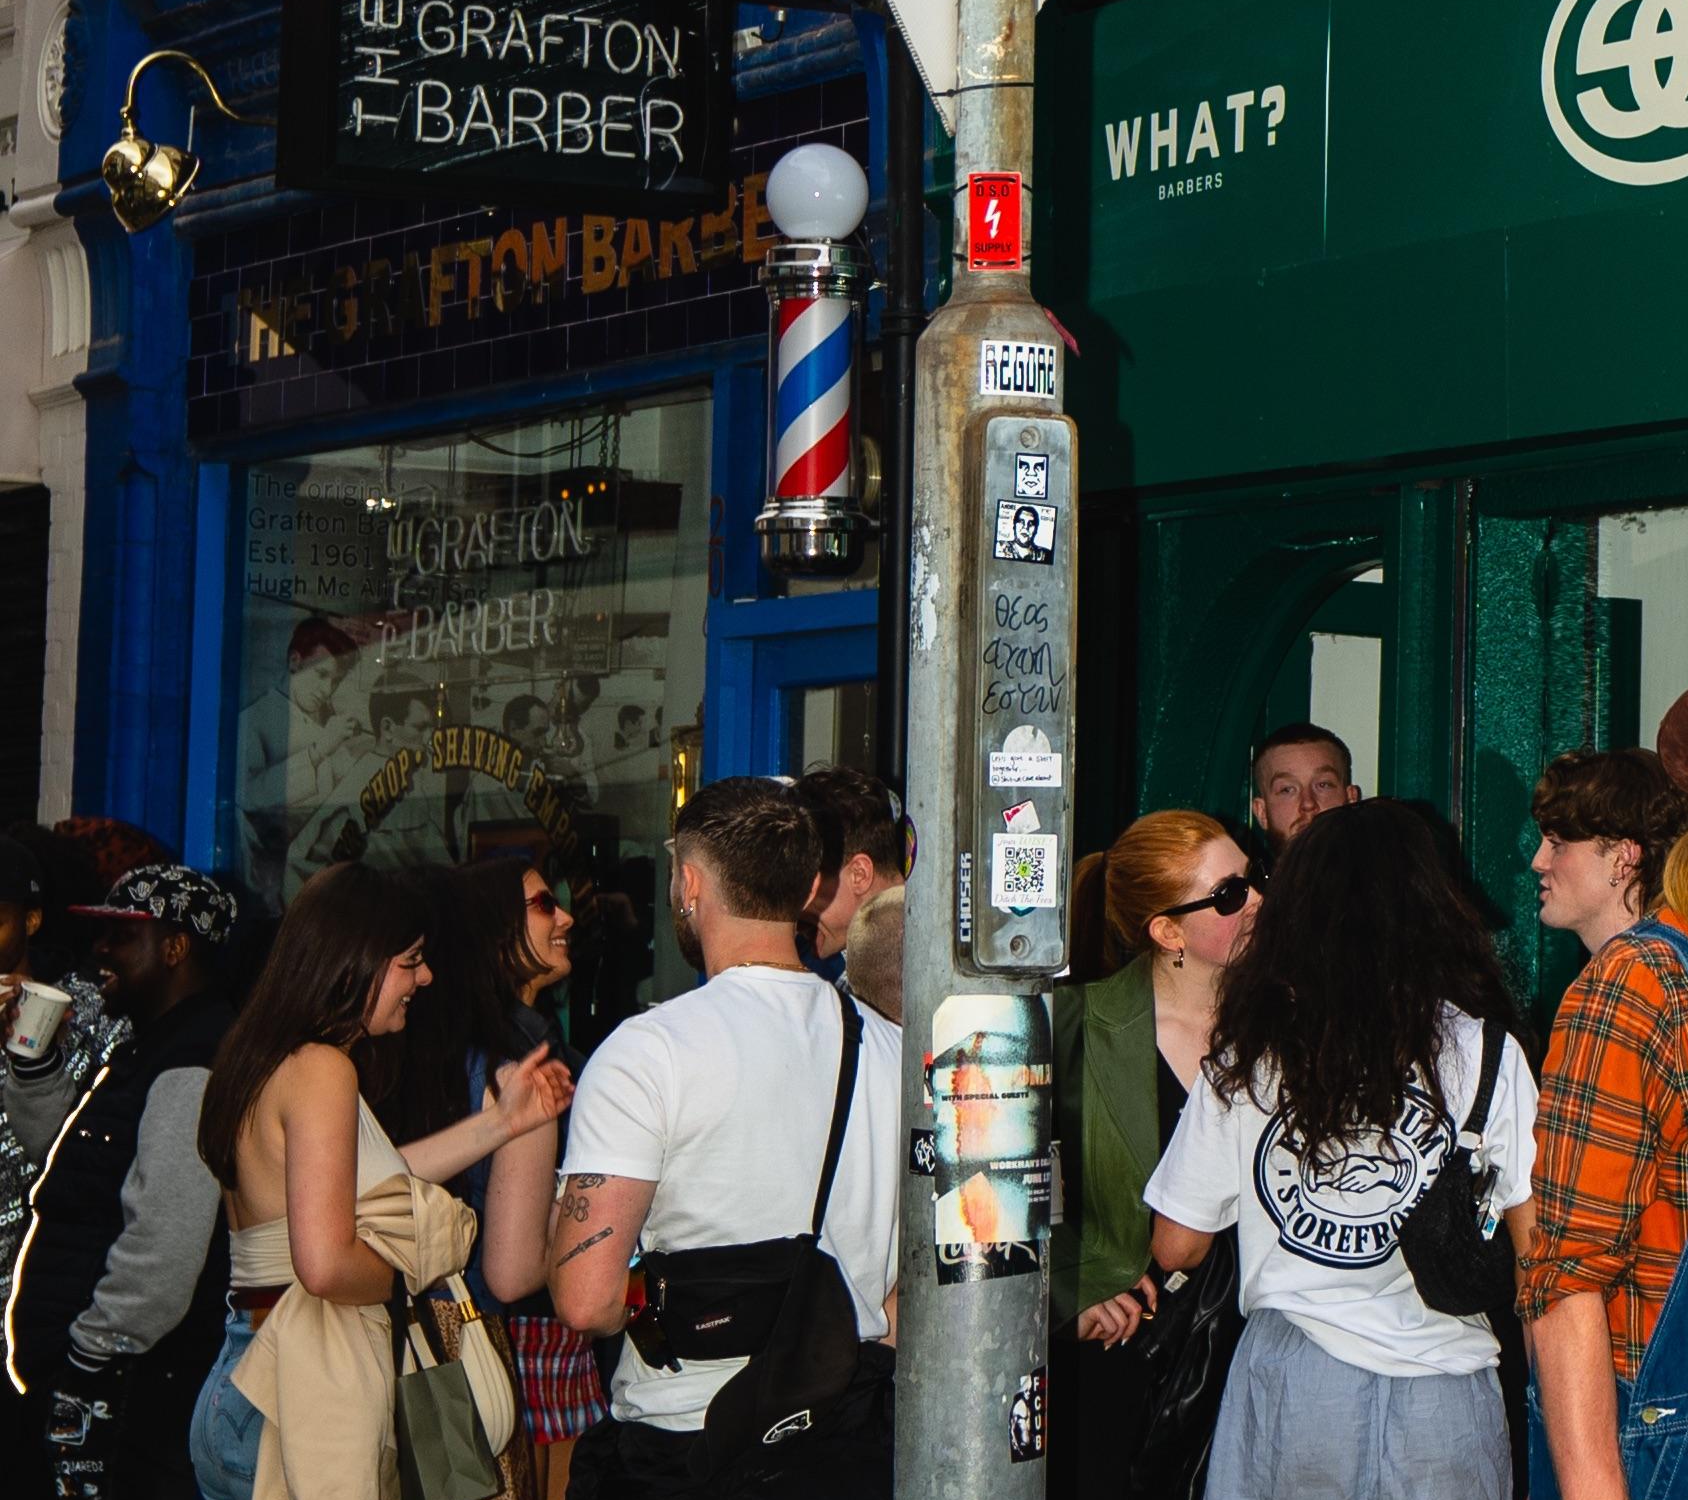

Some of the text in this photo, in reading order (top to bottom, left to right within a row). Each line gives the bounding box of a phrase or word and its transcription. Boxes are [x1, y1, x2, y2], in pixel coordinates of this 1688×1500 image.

[417, 0, 681, 79] GRAFTON
[415, 79, 684, 163] BARBER
[1104, 84, 1287, 182] WHAT?
[1158, 172, 1223, 200] BARBERS
[324, 216, 568, 345] GRAFTON
[580, 170, 779, 296] BARBE
[974, 241, 1014, 254] SUPPLY
[249, 473, 297, 499] The
[248, 506, 347, 533] Grafton
[248, 541, 374, 569] Est. 1961
[246, 572, 307, 600] Hugh
[316, 576, 351, 598] Mc
[431, 725, 524, 792] SHAVING
[960, 852, 972, 942] CHOSER
[963, 1093, 1000, 1101] SPECIAL
[1001, 1091, 1029, 1099] GUESTS
